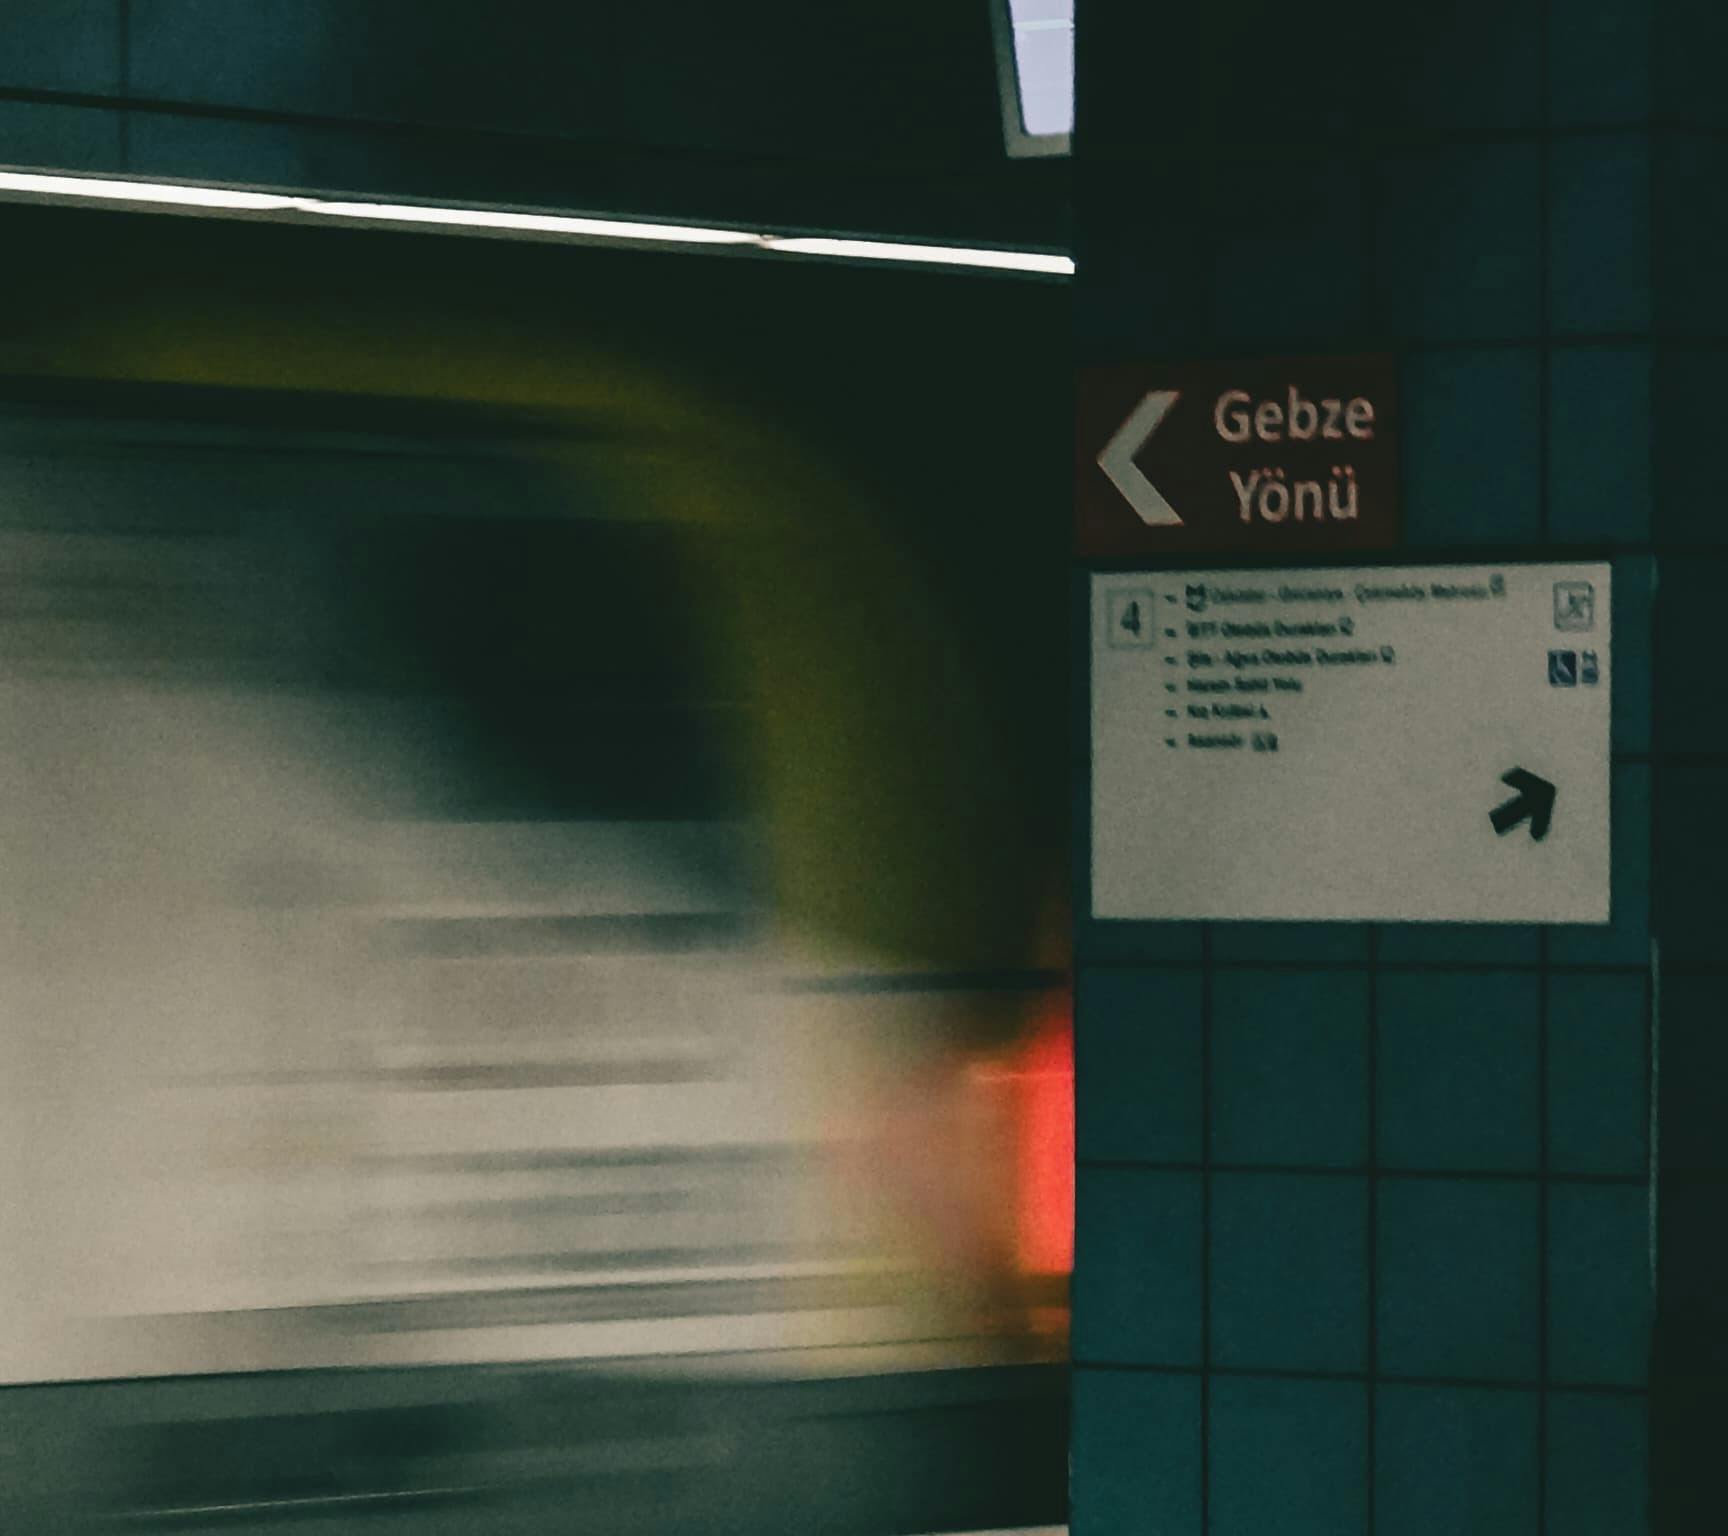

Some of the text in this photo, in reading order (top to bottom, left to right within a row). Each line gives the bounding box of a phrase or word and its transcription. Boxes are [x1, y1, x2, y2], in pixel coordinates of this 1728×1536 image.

[1214, 383, 1375, 443] Gebze
[1228, 465, 1359, 523] Yönü
[1119, 600, 1142, 637] 4
